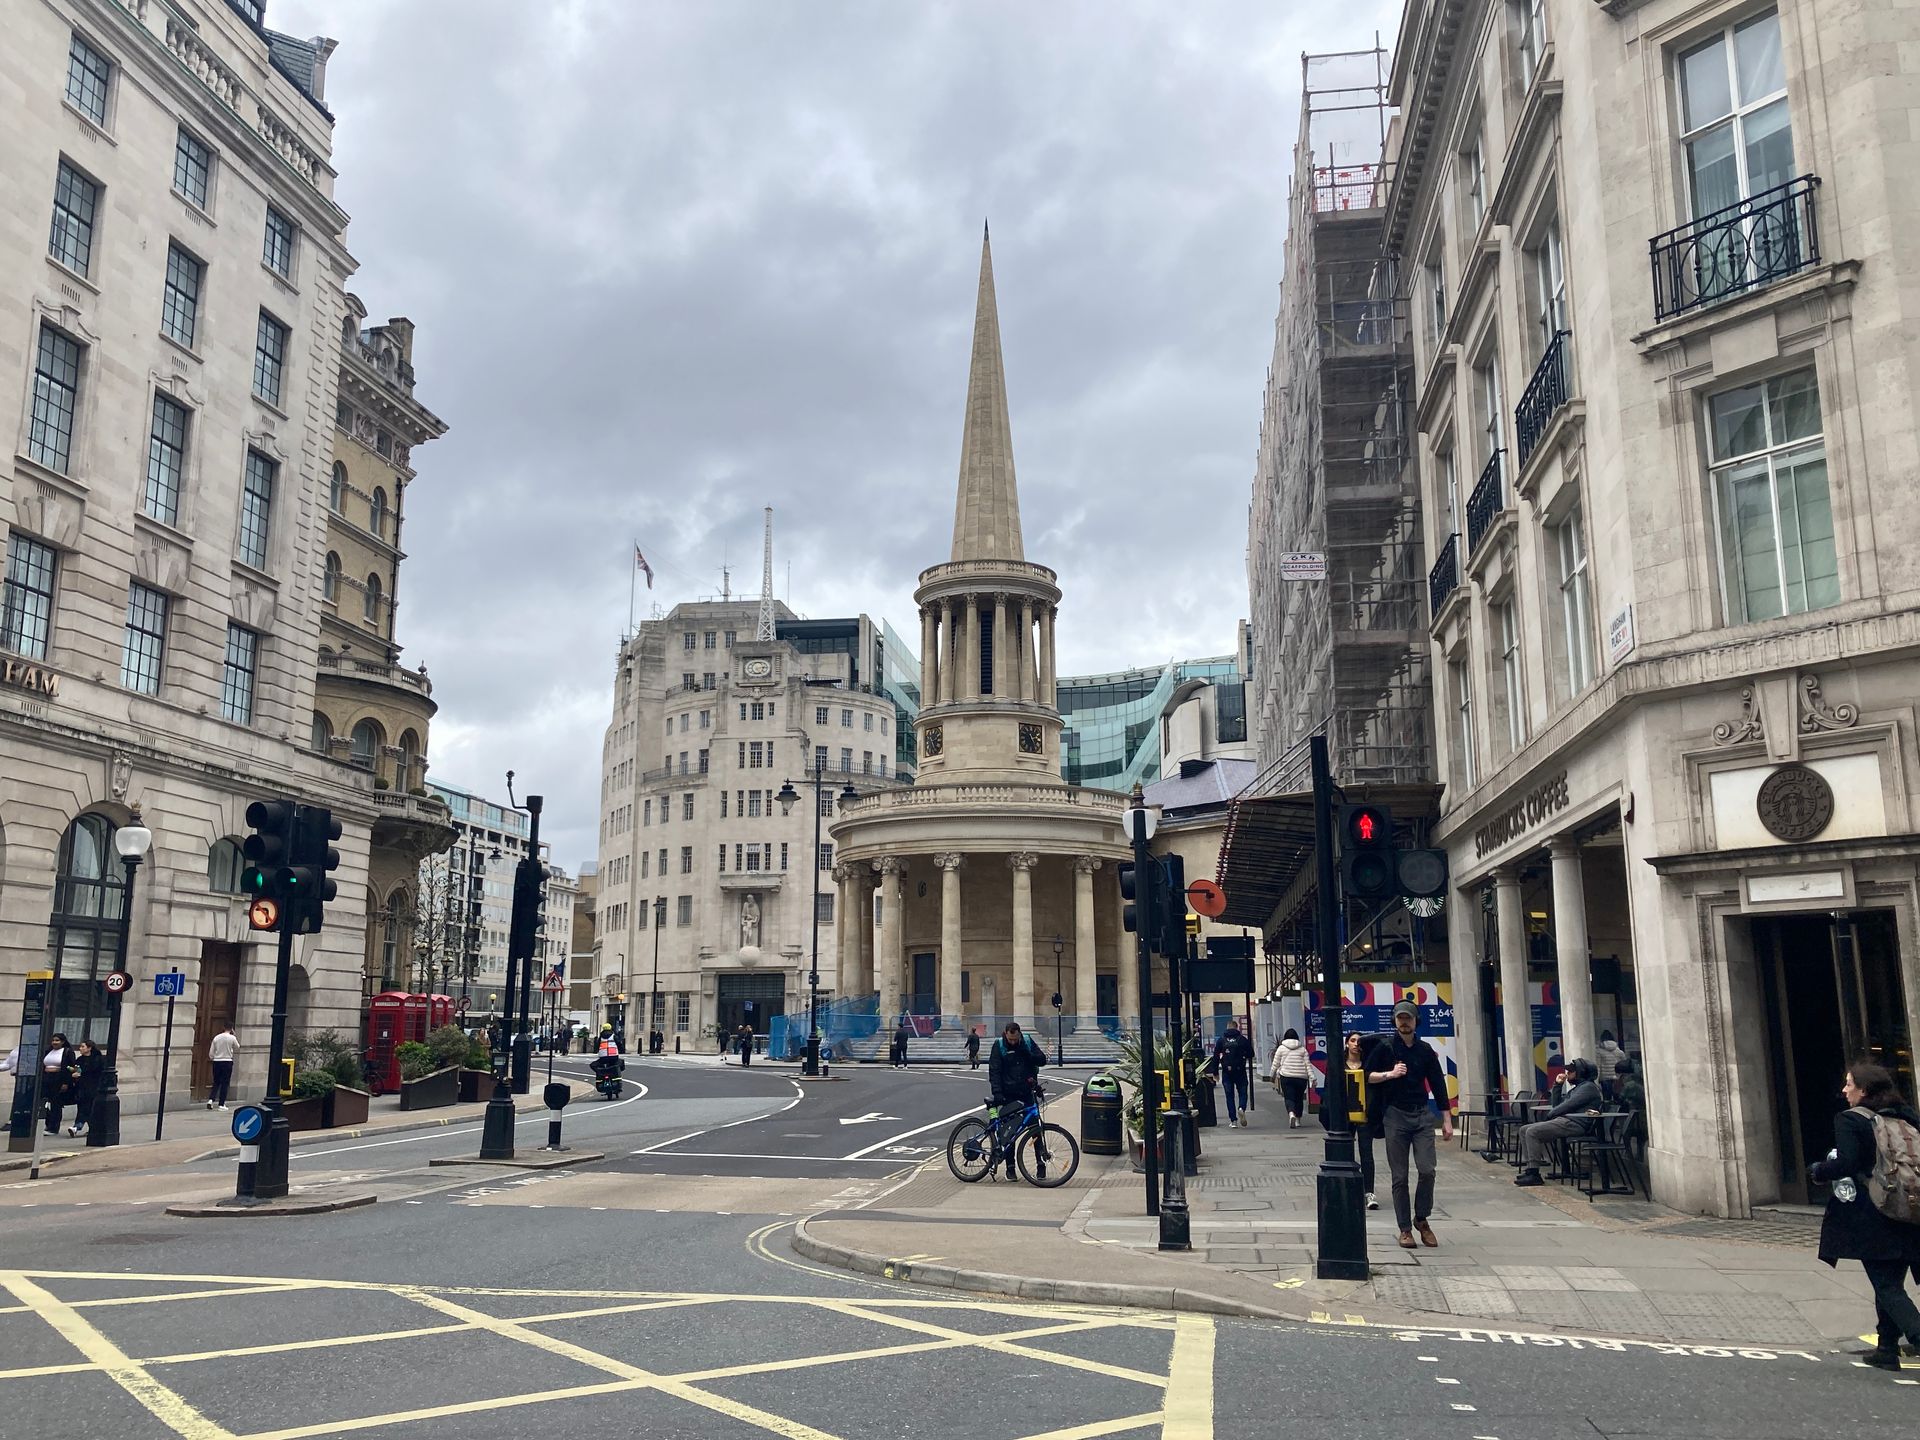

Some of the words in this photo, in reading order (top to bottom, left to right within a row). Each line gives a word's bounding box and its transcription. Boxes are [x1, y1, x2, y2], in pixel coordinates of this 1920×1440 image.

[1761, 770, 1828, 805] STARBUCKS
[1475, 799, 1526, 859] STARBUCKS
[1526, 769, 1570, 827] COFFEE
[109, 977, 123, 986] 20
[1448, 1329, 1628, 1352] RIGHT
[1648, 1341, 1822, 1361] LOOK
